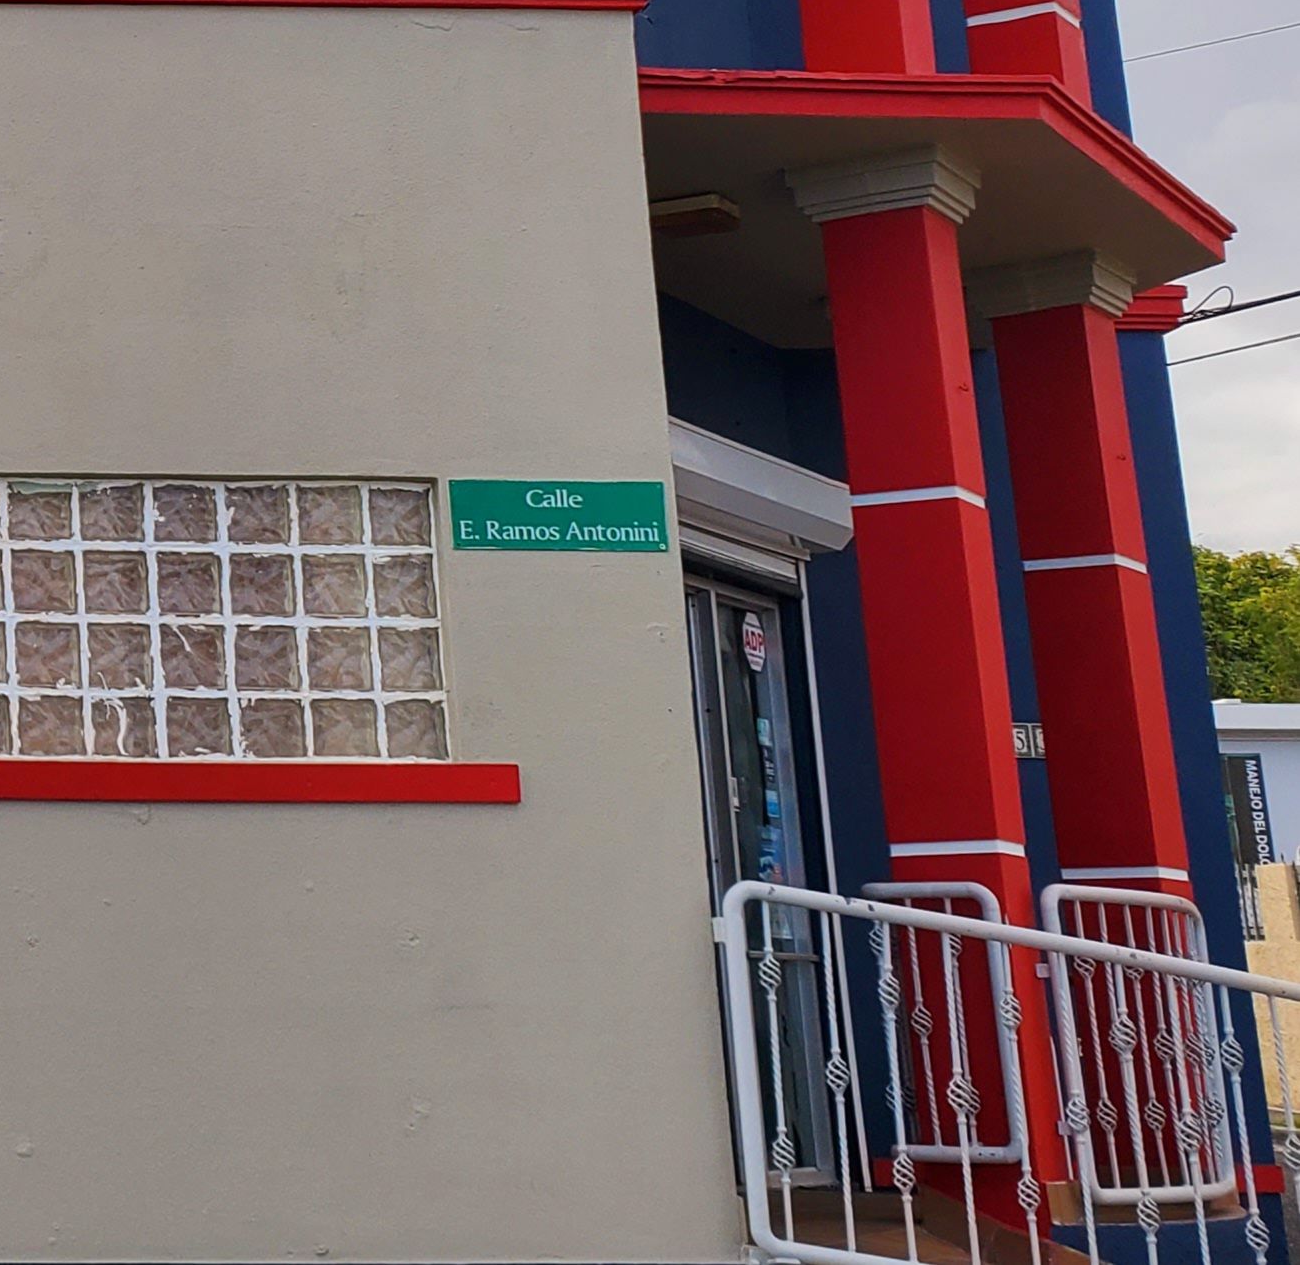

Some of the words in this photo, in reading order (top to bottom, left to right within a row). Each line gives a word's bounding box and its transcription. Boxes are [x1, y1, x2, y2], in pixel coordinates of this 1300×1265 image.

[525, 488, 584, 509] Calle
[459, 520, 480, 540] E.
[486, 520, 561, 541] Ramos
[565, 520, 661, 543] Antonini
[1244, 759, 1263, 810] MANEJO
[1252, 811, 1267, 834] DEL
